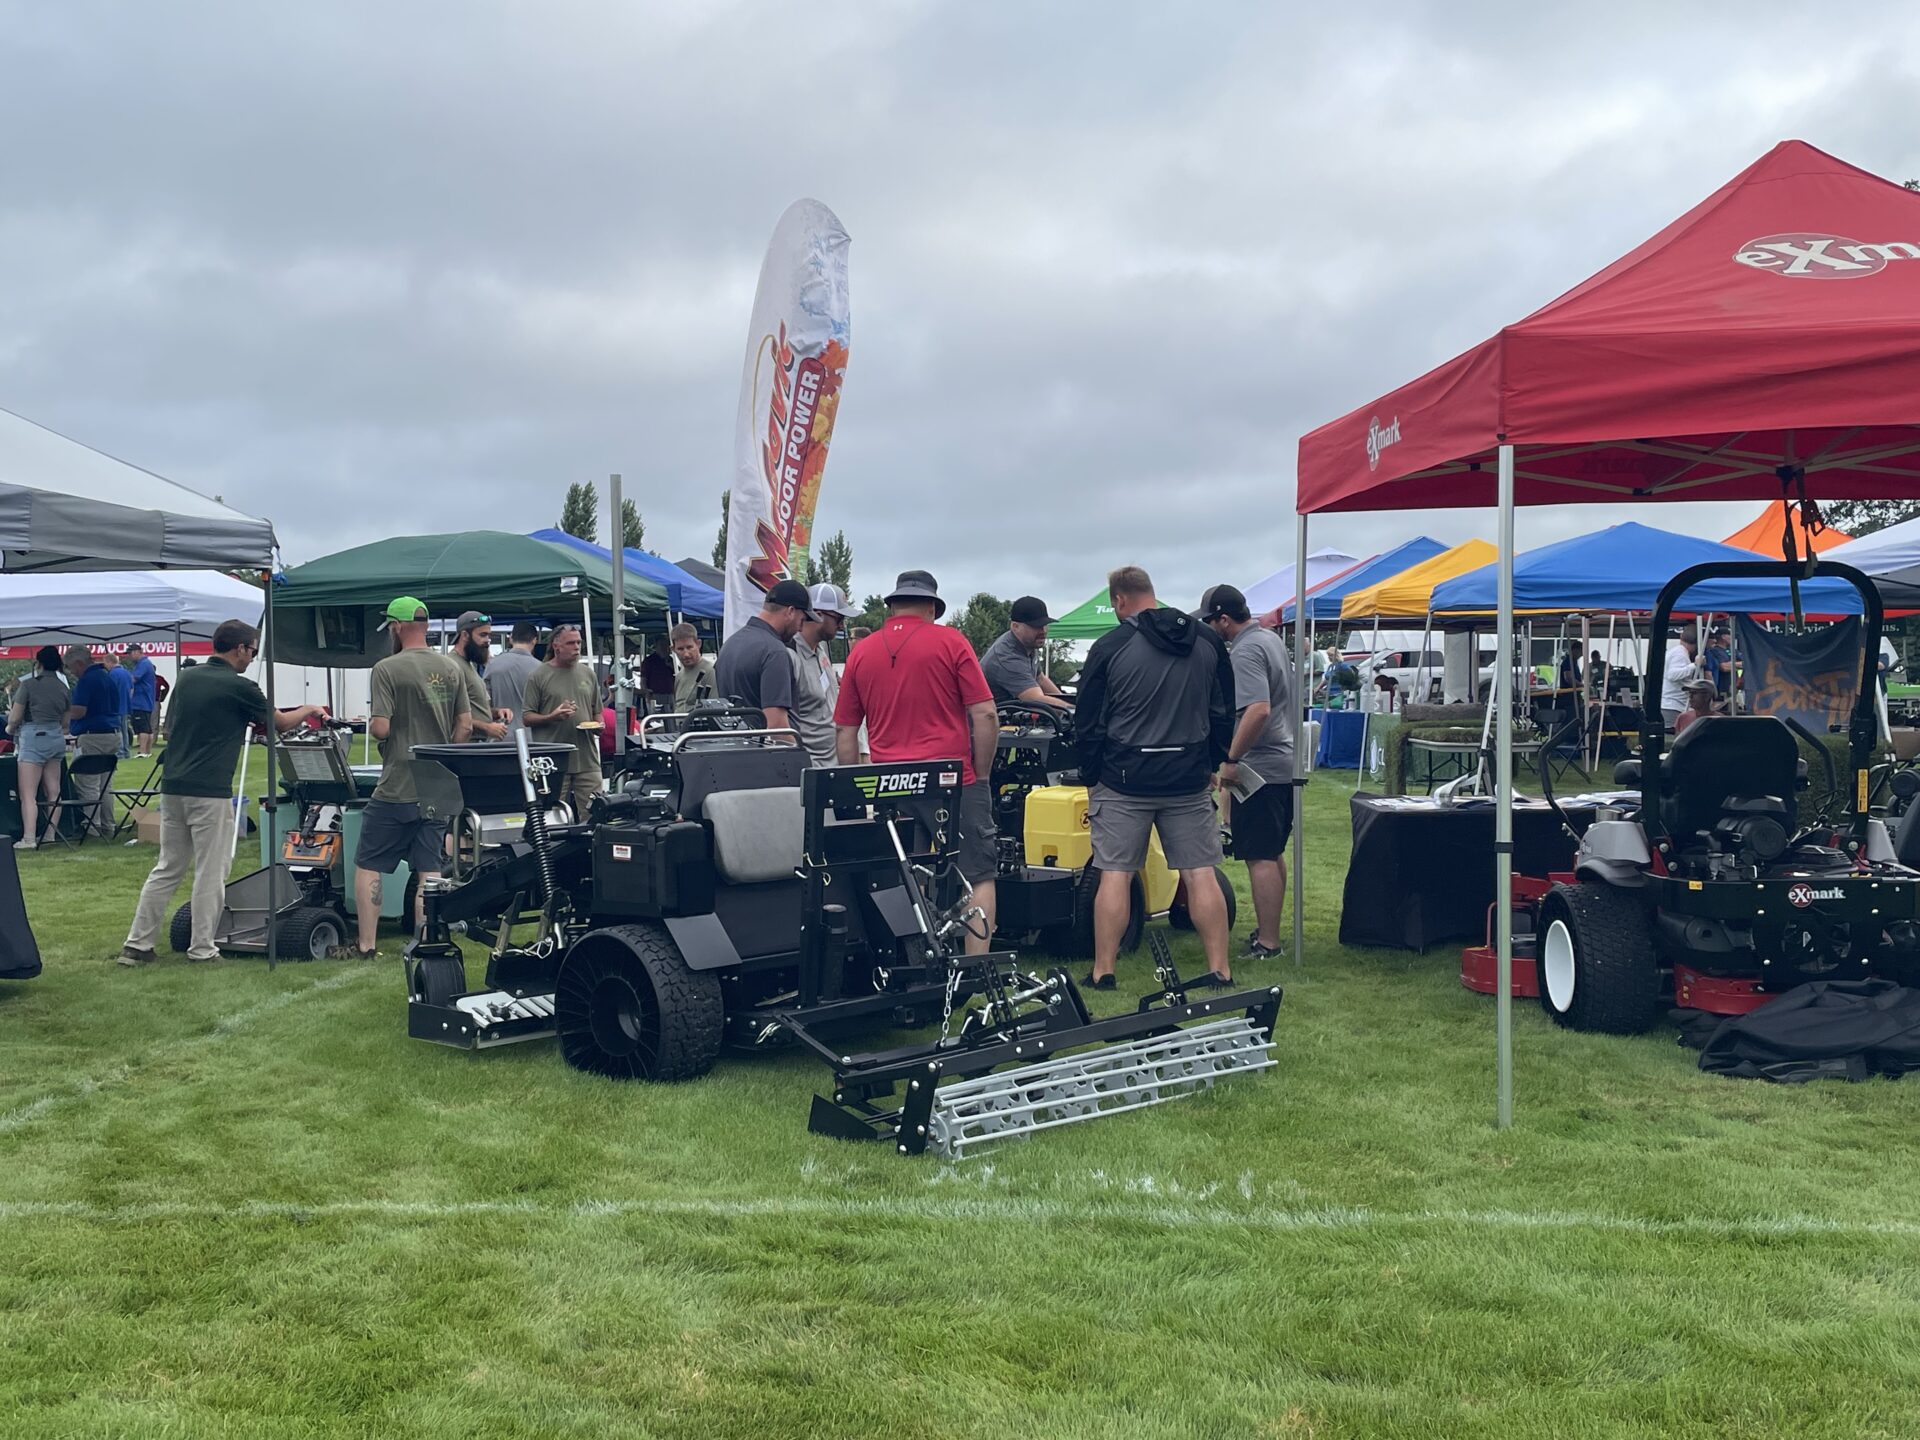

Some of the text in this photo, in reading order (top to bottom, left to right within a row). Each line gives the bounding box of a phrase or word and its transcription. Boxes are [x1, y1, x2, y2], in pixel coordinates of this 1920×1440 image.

[1735, 239, 1920, 275] eXm
[788, 369, 821, 463] POWER
[1366, 415, 1402, 463] eXmark
[879, 772, 929, 792] FORCE
[1787, 886, 1847, 904] eXmark
